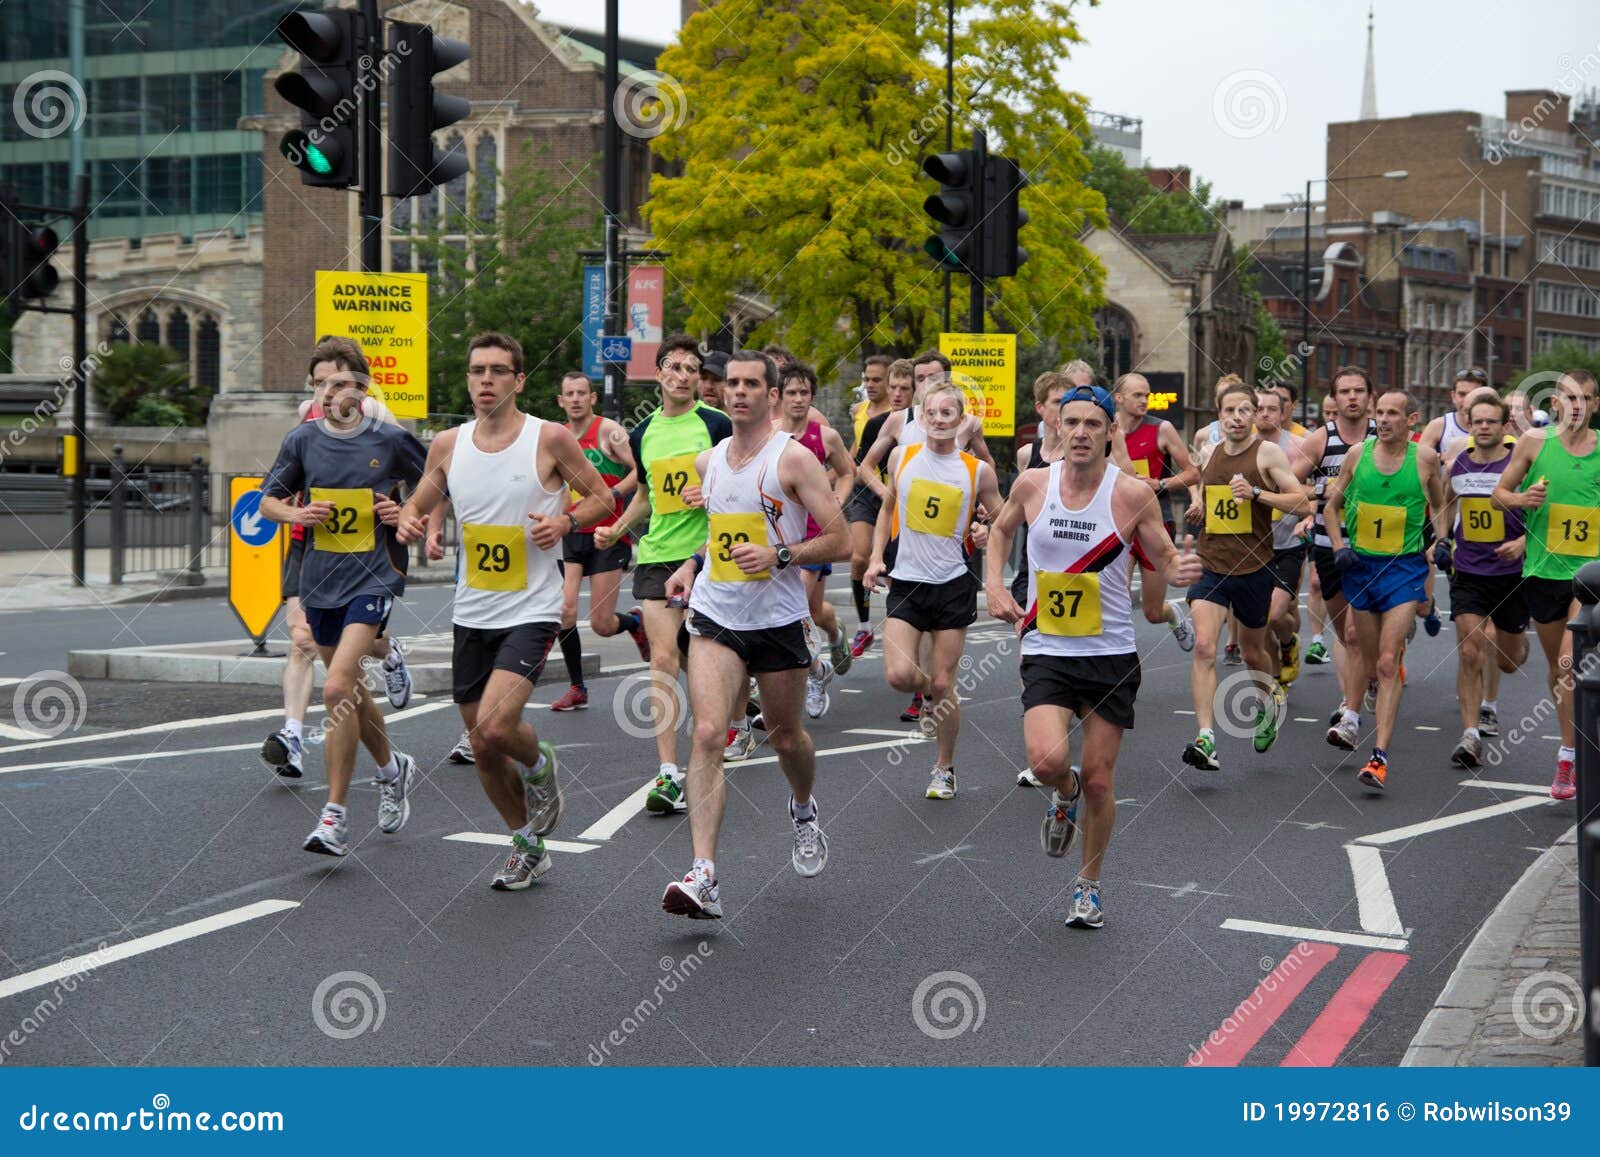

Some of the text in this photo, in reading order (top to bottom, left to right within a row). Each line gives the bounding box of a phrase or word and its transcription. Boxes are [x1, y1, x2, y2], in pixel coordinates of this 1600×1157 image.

[333, 284, 411, 297] ADVANCE
[332, 299, 412, 312] WARNING
[348, 324, 395, 334] MONDAY
[361, 337, 413, 347] MAY 2011
[951, 348, 1005, 357] ADVANCE
[951, 358, 1005, 367] WARNING
[989, 384, 1006, 392] 2011
[383, 391, 424, 402] 3.00pm
[662, 471, 689, 496] 42
[924, 495, 941, 519] 5
[1214, 499, 1239, 520] 48
[326, 507, 359, 534] 32
[1049, 518, 1097, 531] PORT TALBOT
[1469, 510, 1492, 530] 50
[1373, 518, 1383, 539] 1
[1561, 519, 1589, 542] 13
[1053, 530, 1090, 542] HARRIERS
[476, 543, 511, 572] 29
[1048, 590, 1083, 618] 37
